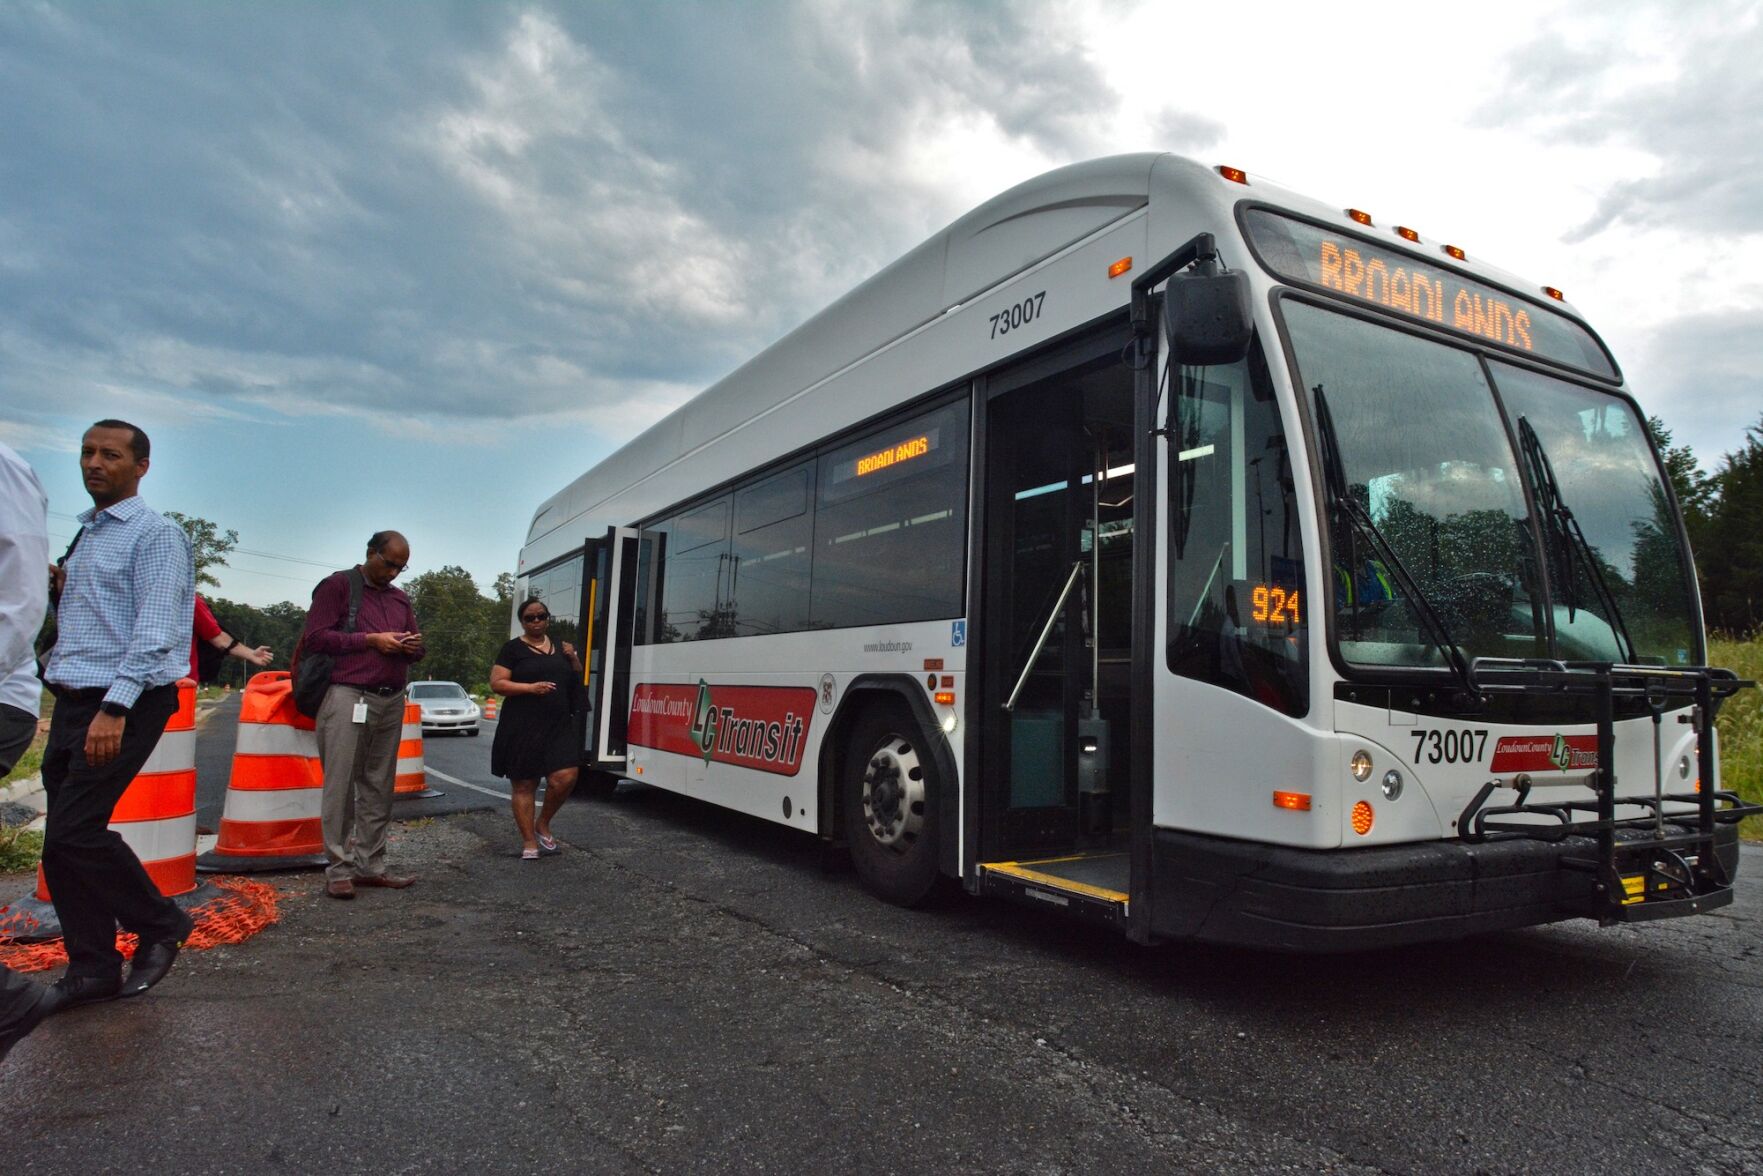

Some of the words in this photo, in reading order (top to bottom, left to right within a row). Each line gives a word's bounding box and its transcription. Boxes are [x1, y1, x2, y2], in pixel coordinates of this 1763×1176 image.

[1320, 240, 1533, 351] BROADLANDS
[989, 290, 1046, 340] 73007
[857, 437, 928, 475] BROADLANDS
[1252, 587, 1300, 623] 924
[863, 640, 913, 654] www.loudoun.gov
[718, 706, 803, 766] Transit
[1411, 729, 1488, 764] 73007
